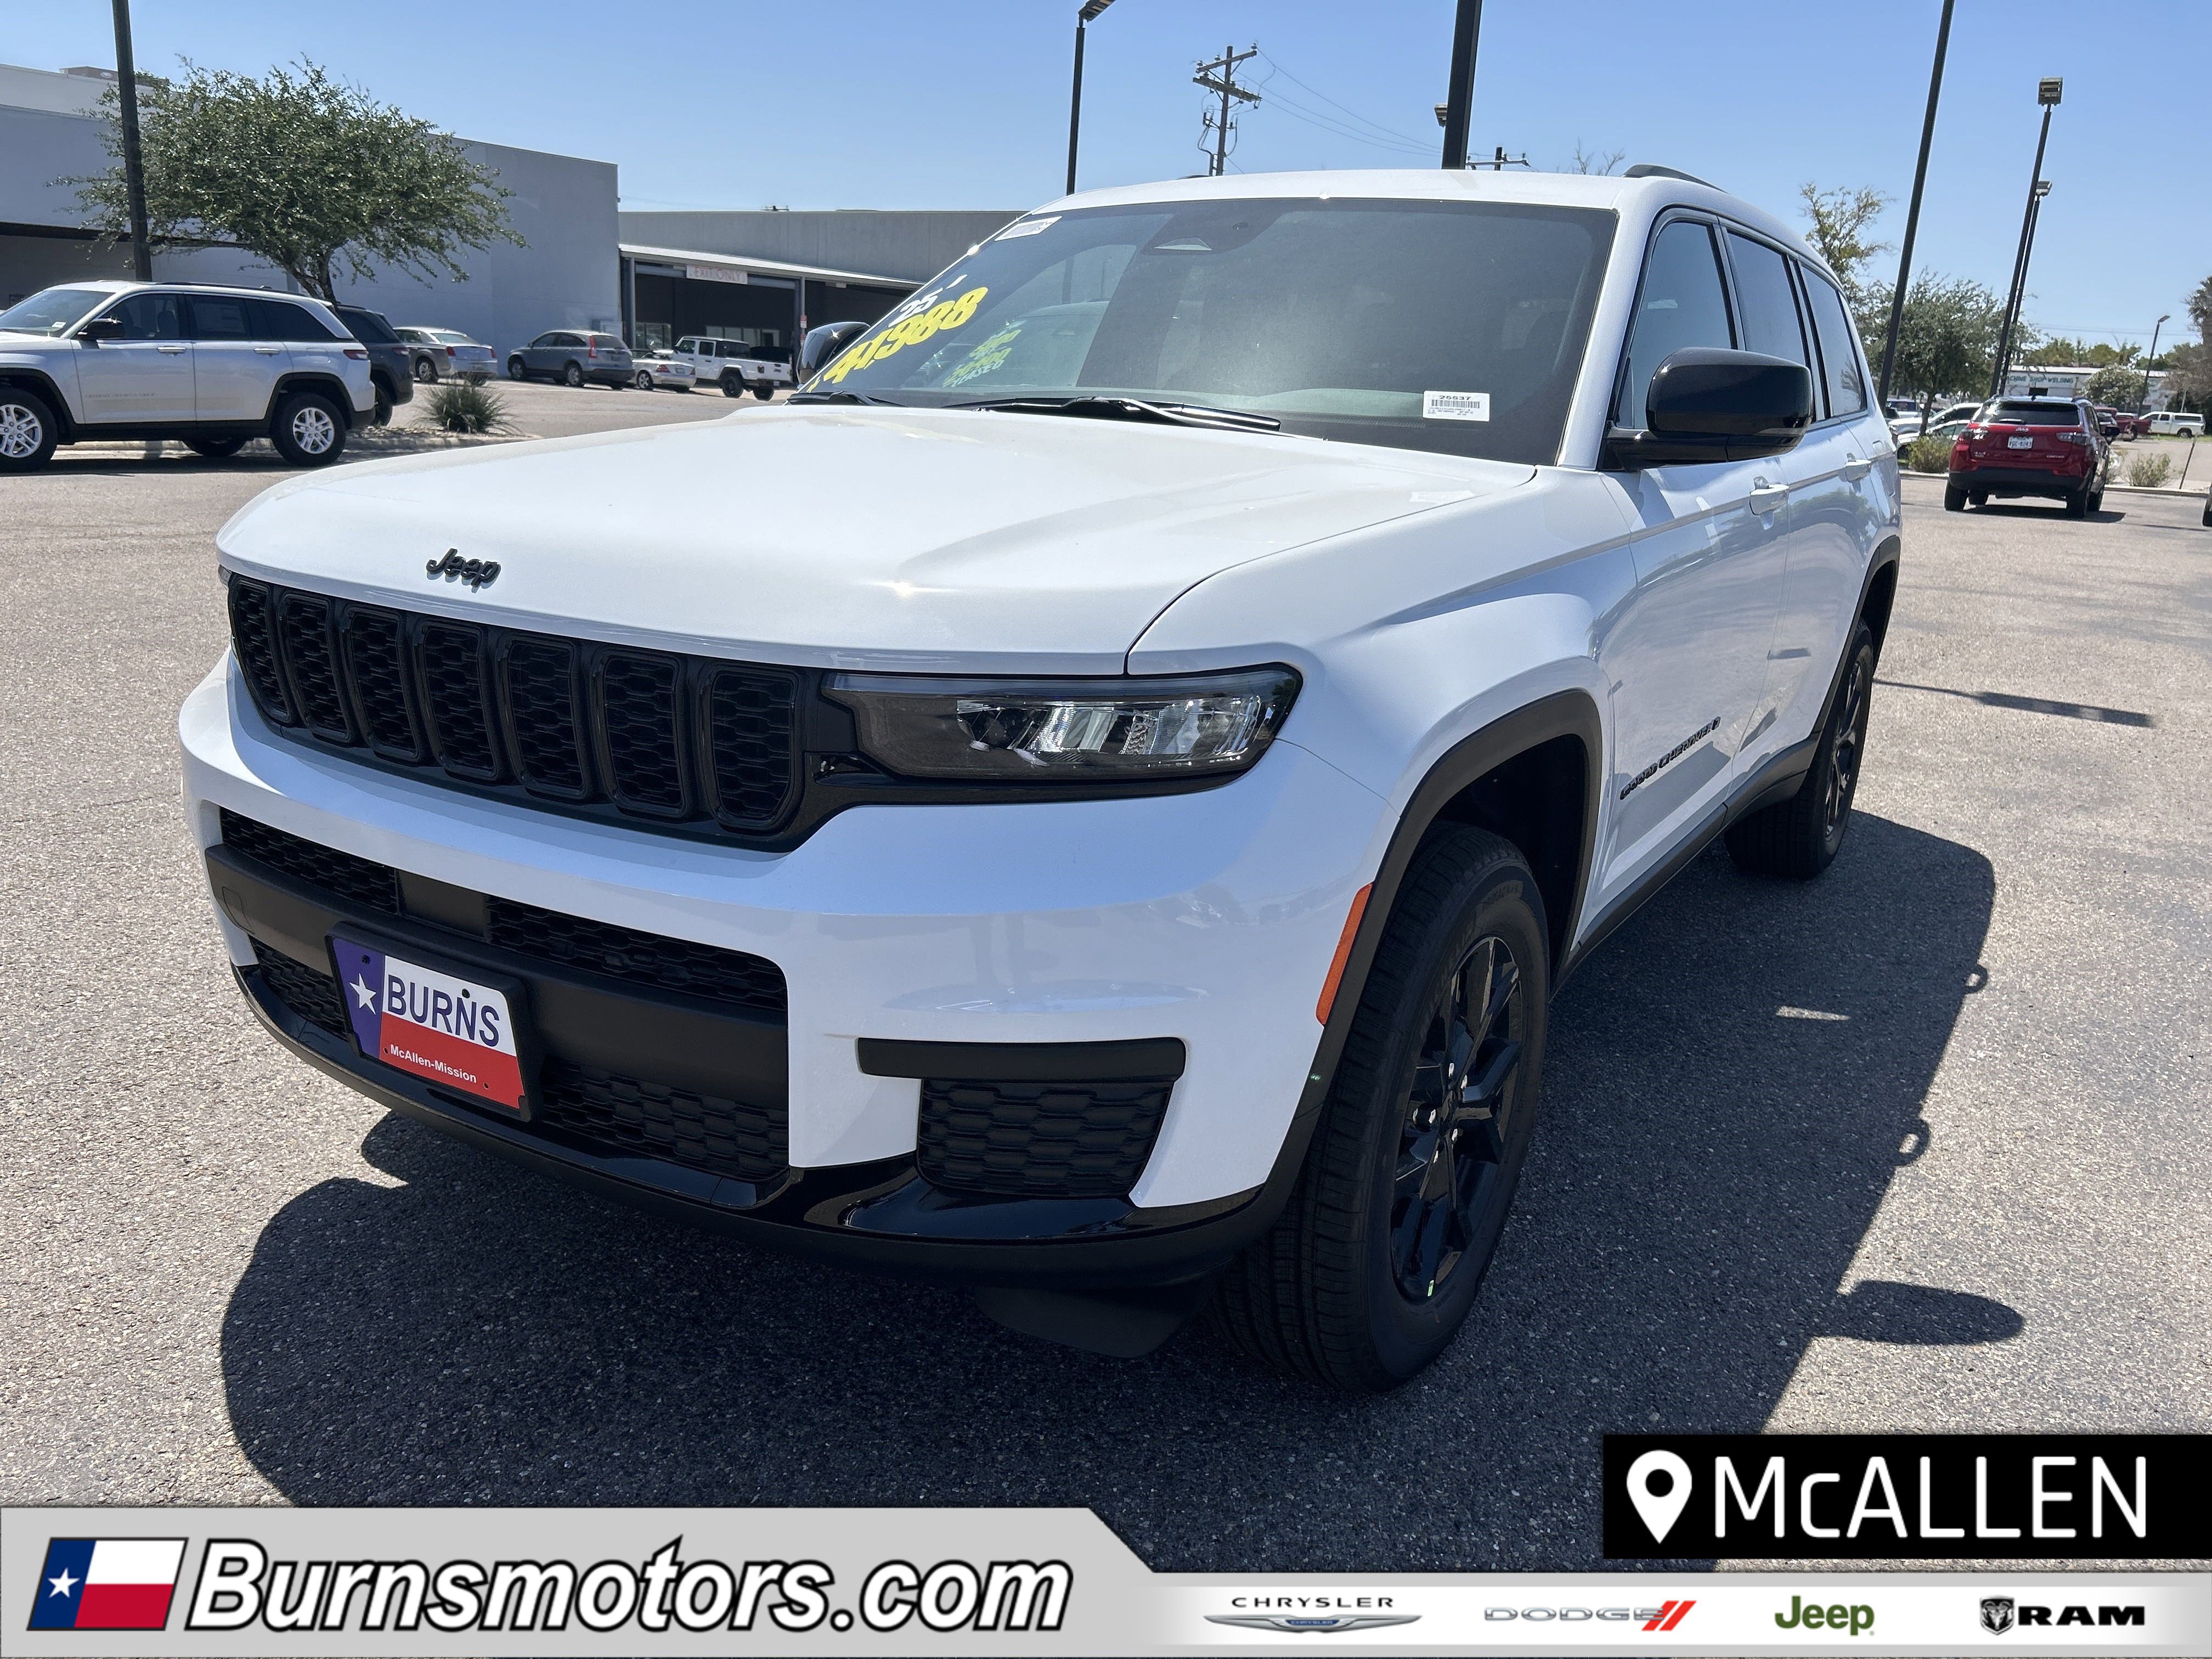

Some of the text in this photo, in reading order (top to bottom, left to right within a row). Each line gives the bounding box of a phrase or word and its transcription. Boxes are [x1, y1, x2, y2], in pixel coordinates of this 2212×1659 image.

[694, 266, 742, 281] EXIT ONLY
[426, 548, 501, 588] Jeep
[387, 974, 500, 1047] BURNS
[390, 1043, 477, 1084] McAllen-Mission
